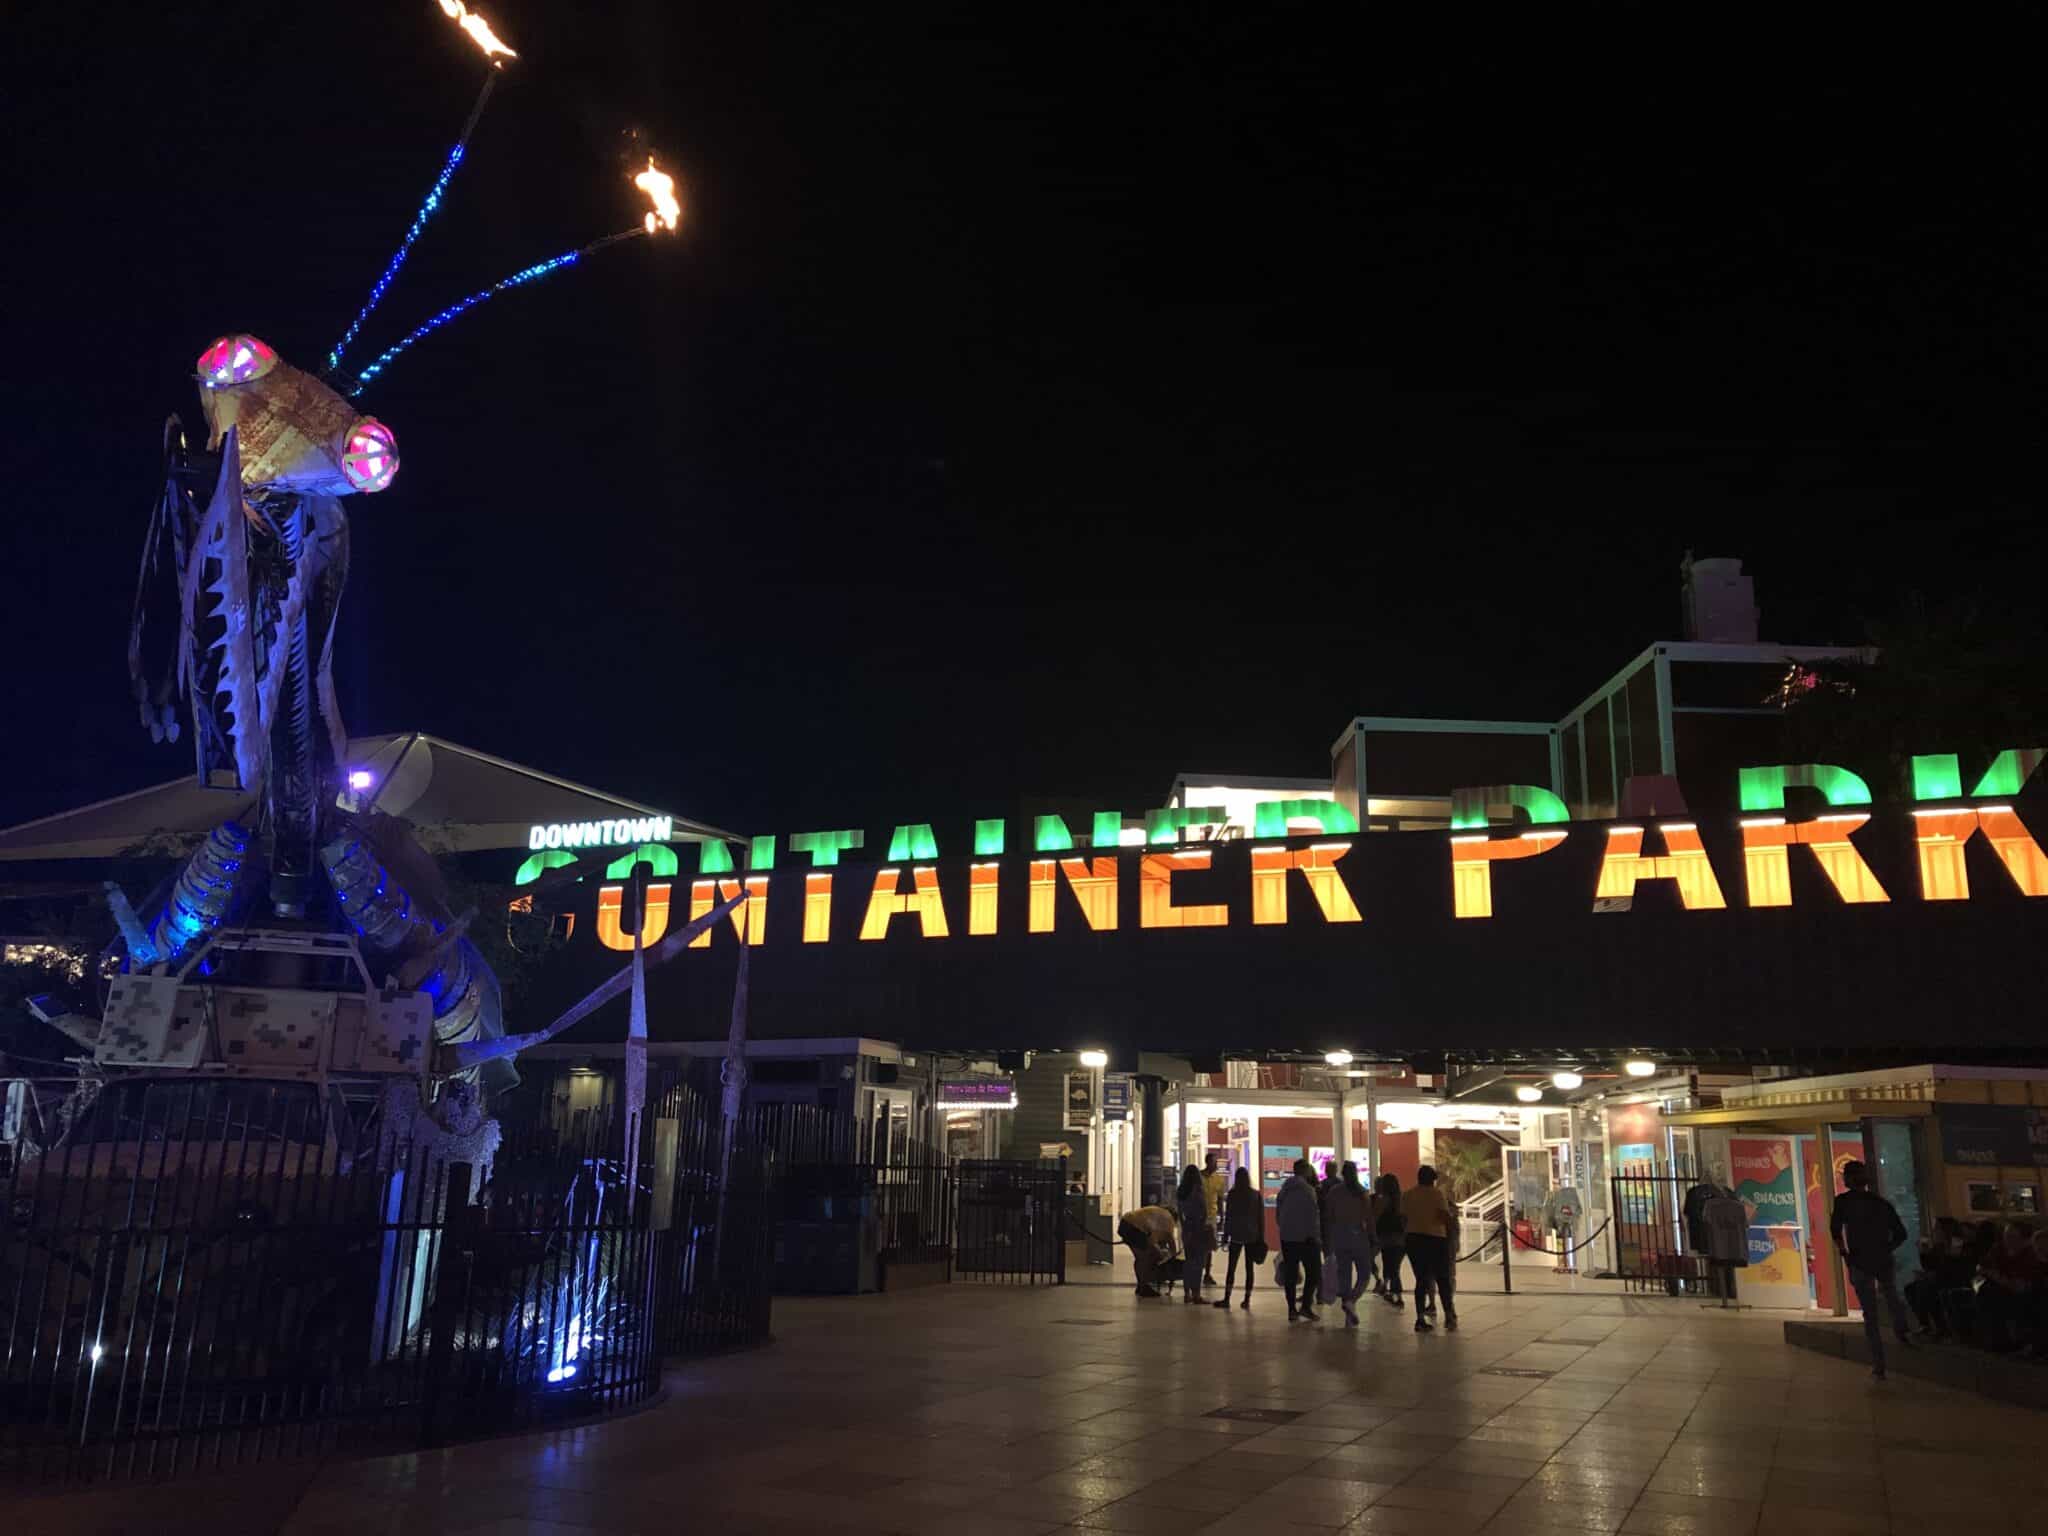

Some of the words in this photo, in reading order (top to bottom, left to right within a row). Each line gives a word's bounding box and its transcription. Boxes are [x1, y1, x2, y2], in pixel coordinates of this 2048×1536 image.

[529, 816, 672, 850] DOWNTOWN
[1451, 747, 2048, 919] PARK
[1734, 1156, 1771, 1169] DRINKS
[1753, 1191, 1796, 1206] SNACKS
[1748, 1239, 1776, 1253] ERCH
